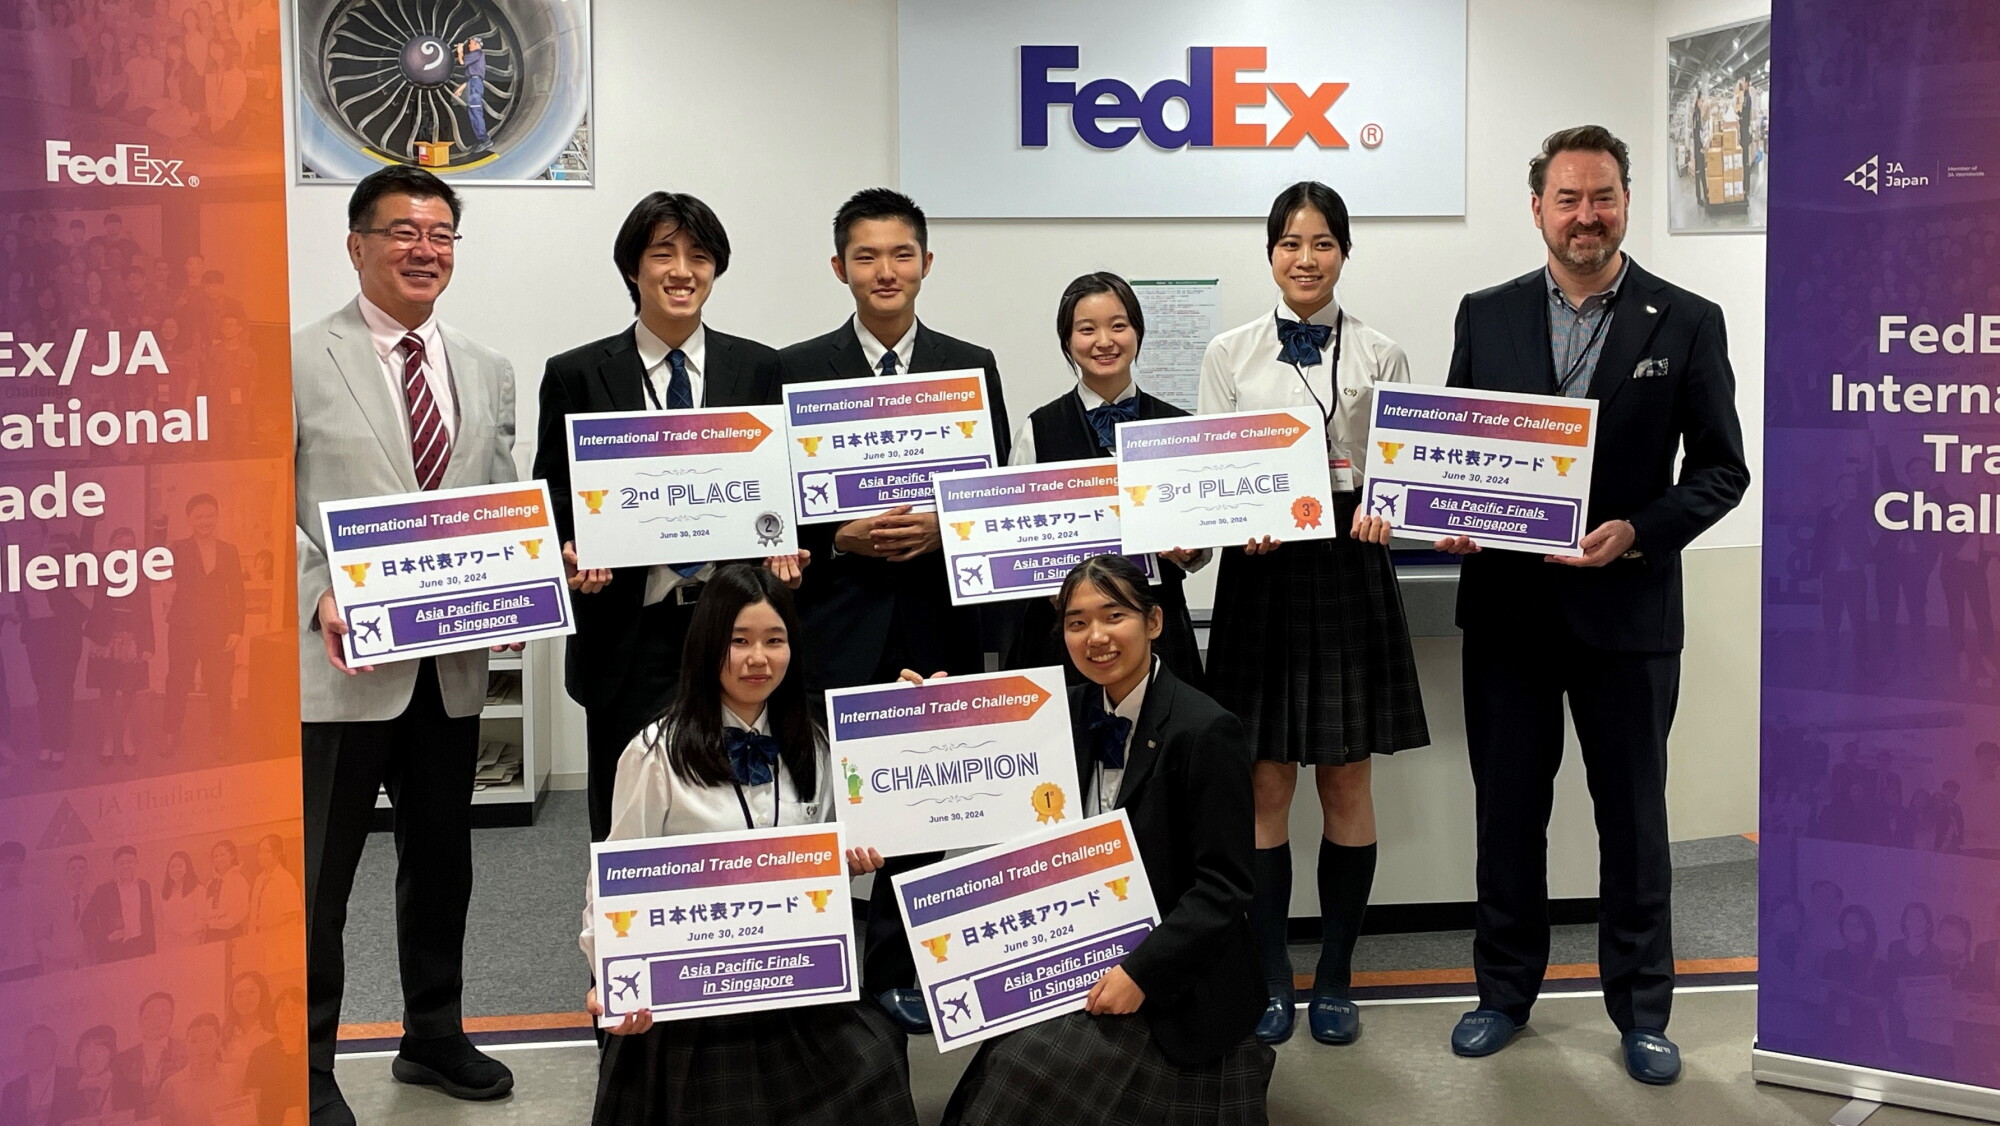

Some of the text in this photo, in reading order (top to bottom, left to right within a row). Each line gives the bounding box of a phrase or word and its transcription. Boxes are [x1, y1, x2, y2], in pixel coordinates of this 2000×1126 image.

[1020, 45, 1350, 149] FedEx
[46, 140, 185, 187] FedEx
[1885, 162, 1904, 173] JA
[1885, 176, 1929, 188] Japan
[1879, 313, 2000, 354] FedE
[796, 390, 976, 414] International Trade Challenge
[1832, 374, 2000, 414] Intern
[1383, 404, 1582, 435] International Trade Challenge
[579, 427, 762, 446] International Trade Challenge
[832, 426, 951, 449] 日本代表アワード
[1126, 426, 1300, 449] International Trade Challenge
[863, 448, 925, 461] June 30, 2024
[1413, 445, 1545, 472] 日本代表アワード
[858, 477, 884, 489] Asia
[887, 472, 925, 486] Pacific
[1157, 473, 1290, 503] 3rd PLACE
[1442, 470, 1510, 485] June 30, 2024
[620, 480, 761, 509] 2nd PLACE
[878, 489, 889, 501] in
[947, 484, 1026, 501] International
[1029, 481, 1064, 492] Trade
[1430, 497, 1546, 519] Asia Pacific Finals
[338, 504, 540, 537] International Trade Challenge
[984, 509, 1105, 533] 日本代表アワード
[1199, 516, 1248, 526] June 30, 2024
[1448, 513, 1528, 534] in Singapore
[660, 529, 710, 539] June 30, 2024
[1017, 530, 1079, 543] June 30, 2024
[0, 545, 174, 597] lenge
[381, 546, 515, 577] 日本代表アワード
[1013, 558, 1039, 570] Asia
[1042, 554, 1081, 567] Pacific
[419, 573, 487, 589] June 30, 2024
[1033, 570, 1045, 581] in
[416, 595, 531, 623] Asia Pacific Finals
[438, 613, 519, 635] in Singapore
[839, 692, 1039, 725] International Trade Challenge
[871, 752, 1040, 794] CHAMPION
[929, 810, 984, 823] June 30, 2024
[606, 849, 832, 881] International Trade Challenge
[913, 838, 1122, 910] International Trade Challenge
[649, 897, 800, 927] 日本代表アワード
[961, 888, 1102, 947] 日本代表アワード
[687, 925, 764, 941] June 30, 2024
[1003, 924, 1075, 954] June 30, 2024
[678, 953, 810, 980] Asia Pacific Finals
[1004, 943, 1124, 992] Asia Pacific Finals
[703, 974, 794, 995] in Singapore
[1029, 987, 1043, 1003] in
